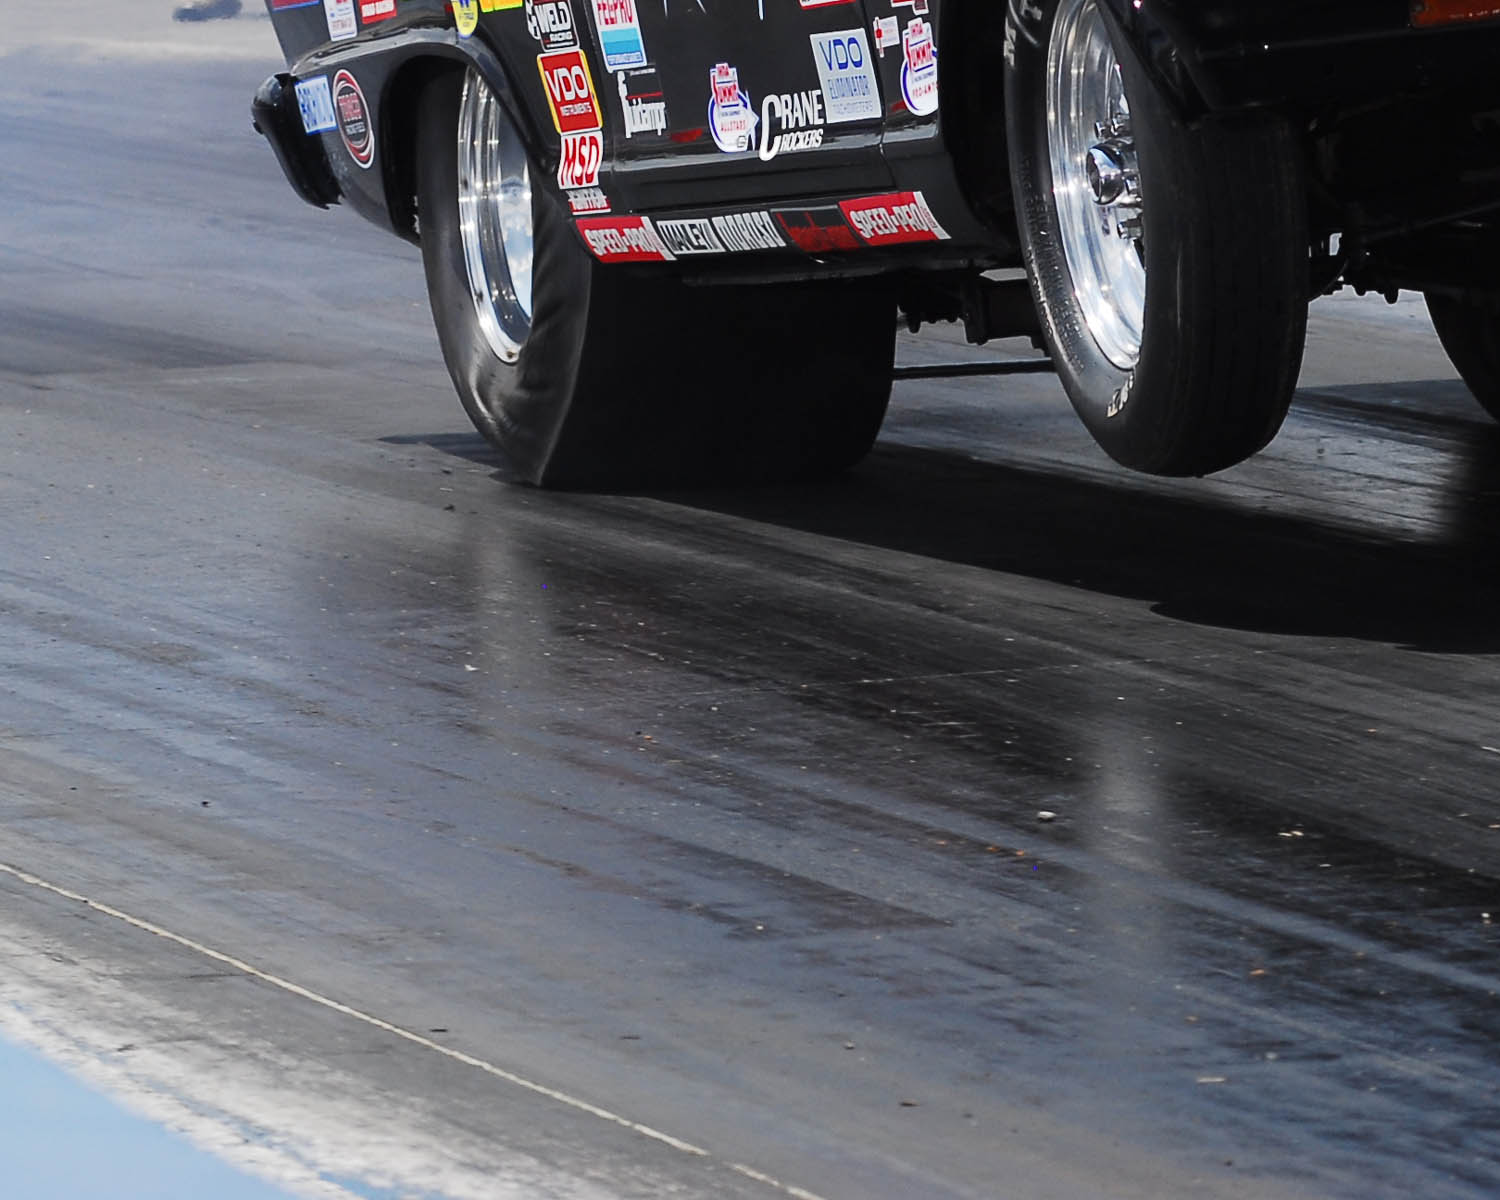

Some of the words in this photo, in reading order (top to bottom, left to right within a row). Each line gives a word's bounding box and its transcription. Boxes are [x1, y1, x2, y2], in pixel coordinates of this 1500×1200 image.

[819, 37, 863, 71] VDO
[545, 64, 590, 103] VDO
[827, 75, 870, 100] ELIMINATOR
[759, 89, 825, 161] CRANE
[780, 128, 824, 152] ROCKERS
[561, 135, 600, 187] MSD
[711, 211, 787, 252] MOROSO
[849, 202, 931, 239] SPEED-PRO
[584, 227, 661, 256] SPEED-PRO
